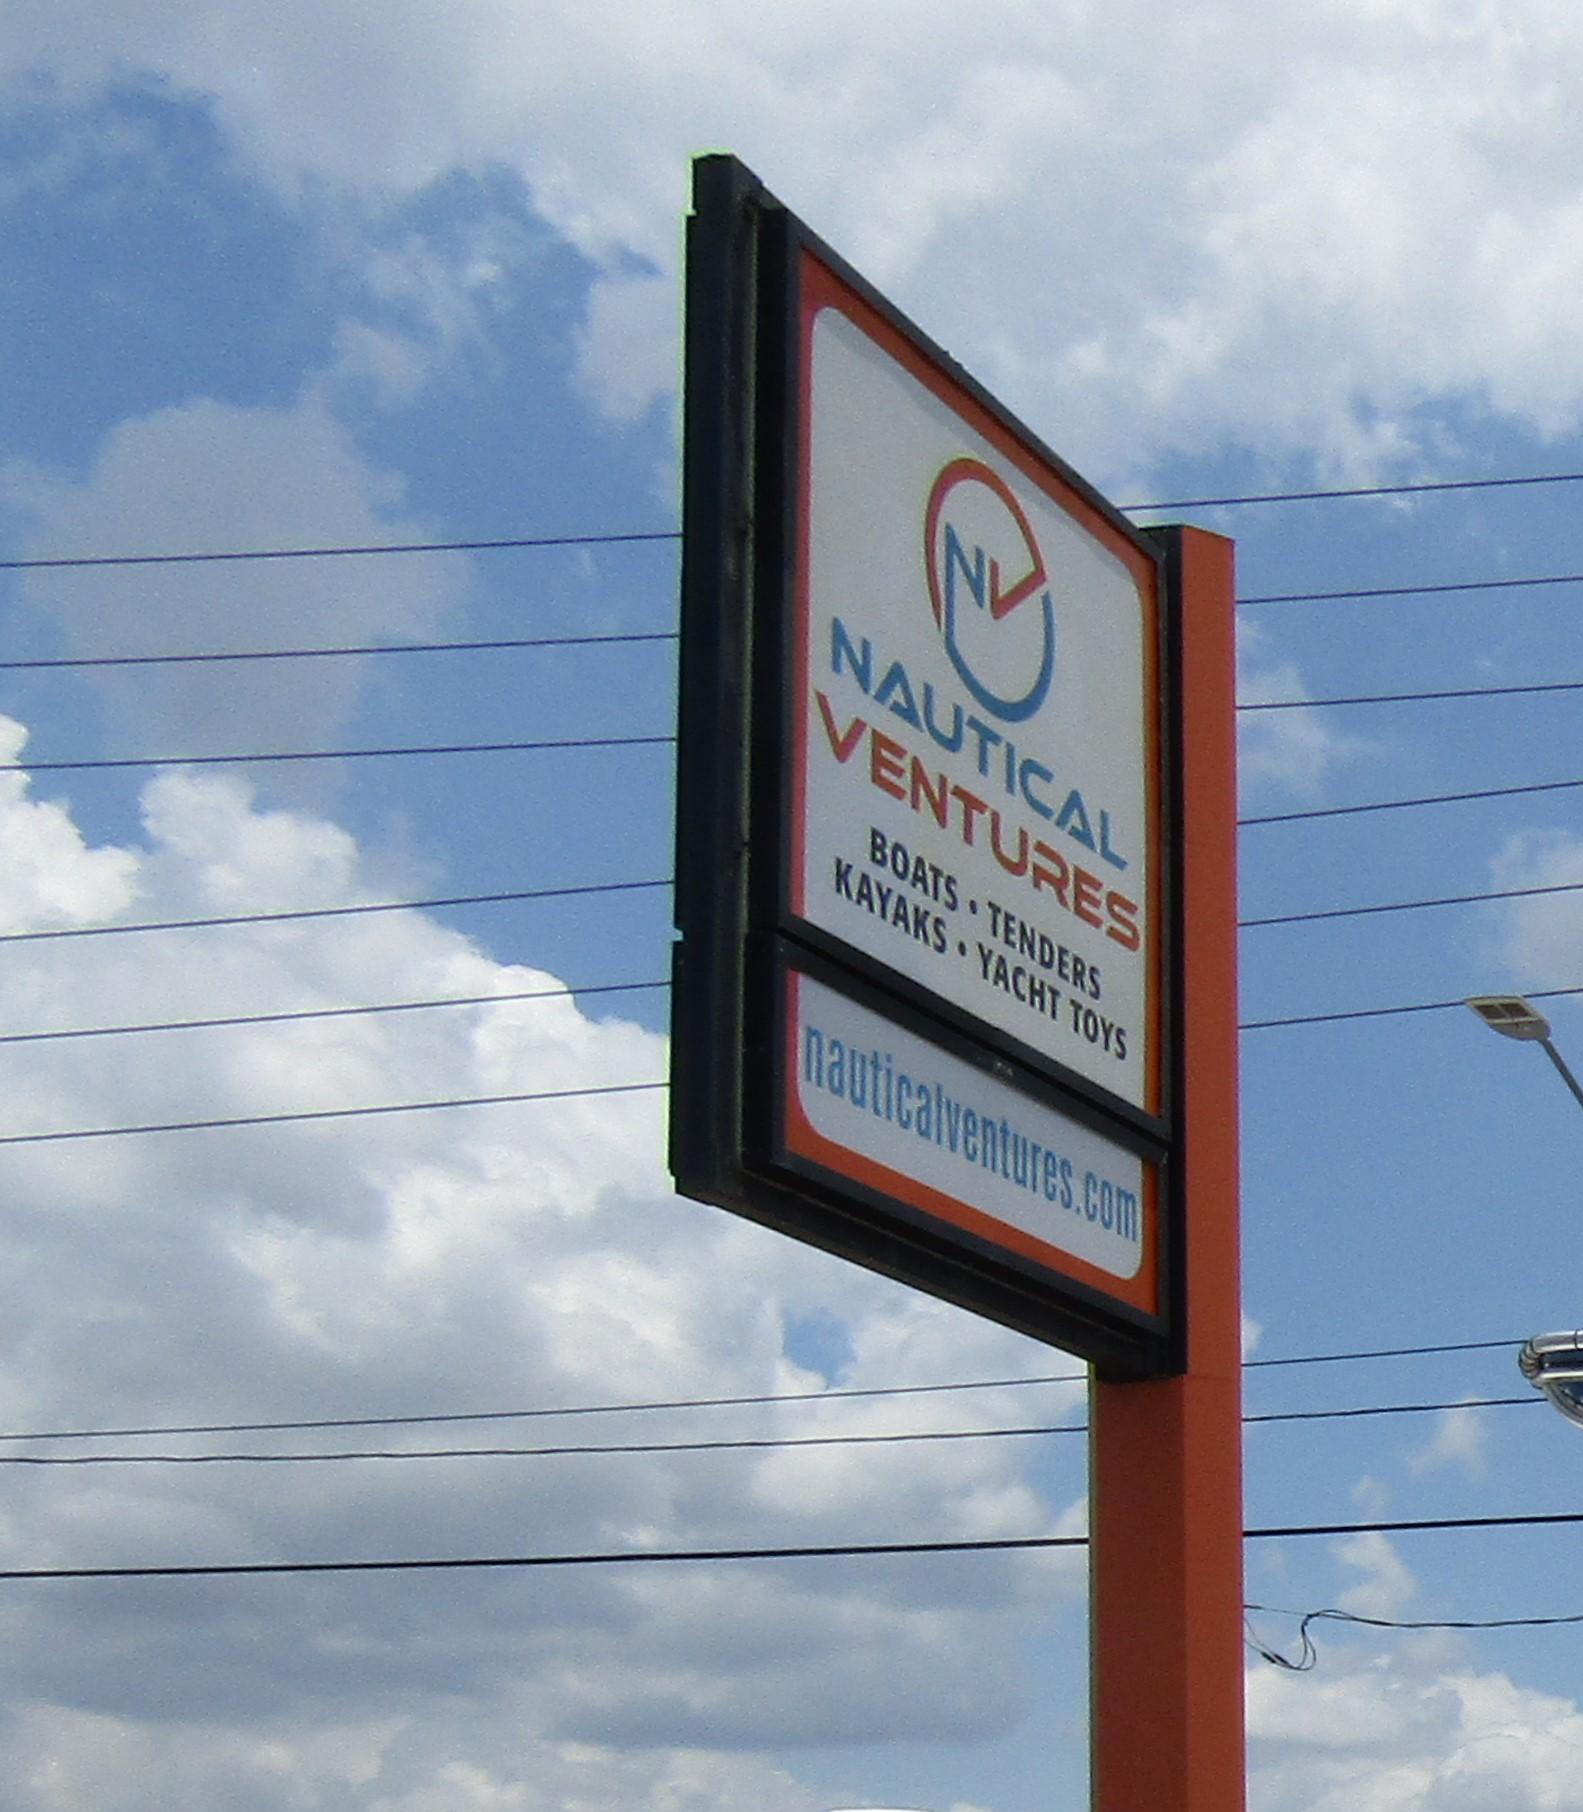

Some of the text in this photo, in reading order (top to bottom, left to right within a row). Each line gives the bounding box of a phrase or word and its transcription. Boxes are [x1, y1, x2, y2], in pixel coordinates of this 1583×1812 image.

[813, 687, 1142, 953] VENTURES
[830, 615, 1129, 871] NAUTICAL
[834, 857, 1128, 1061] KAYAKS YACHT TOYS
[868, 825, 1101, 1001] BOATS TENDERS
[804, 1025, 1138, 1243] nauticalventures.com
